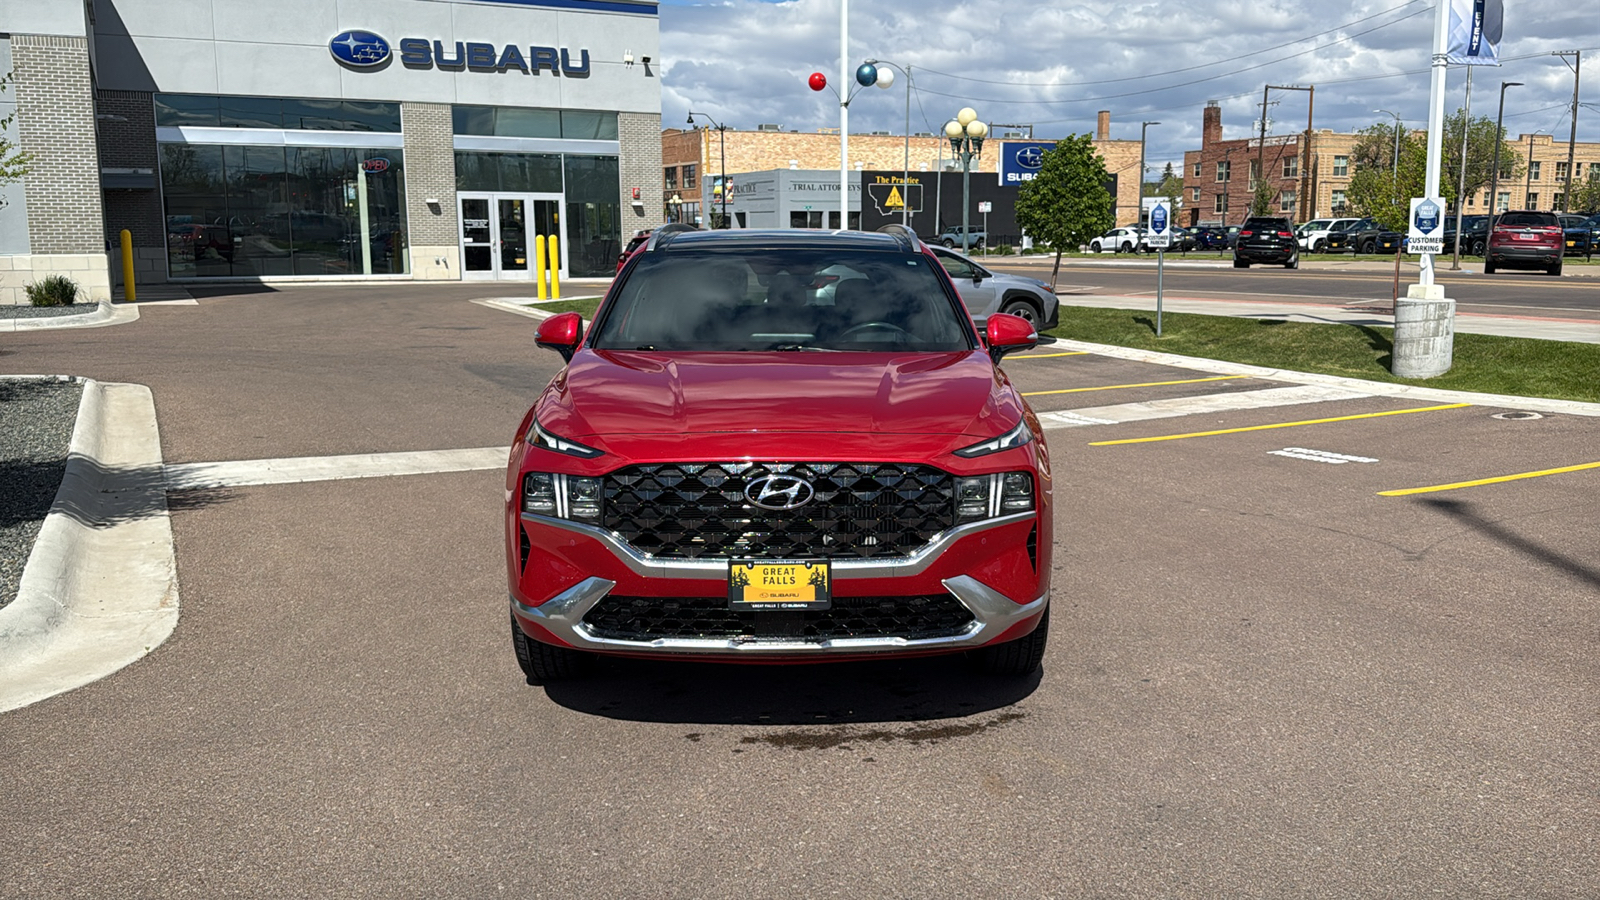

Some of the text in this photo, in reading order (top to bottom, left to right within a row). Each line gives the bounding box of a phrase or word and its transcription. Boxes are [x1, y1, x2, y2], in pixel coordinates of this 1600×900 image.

[400, 37, 589, 75] SUBARU
[362, 160, 387, 170] OPEN
[875, 176, 919, 184] The Pratice
[1007, 172, 1038, 181] SUBA
[763, 576, 796, 585] FALLS
